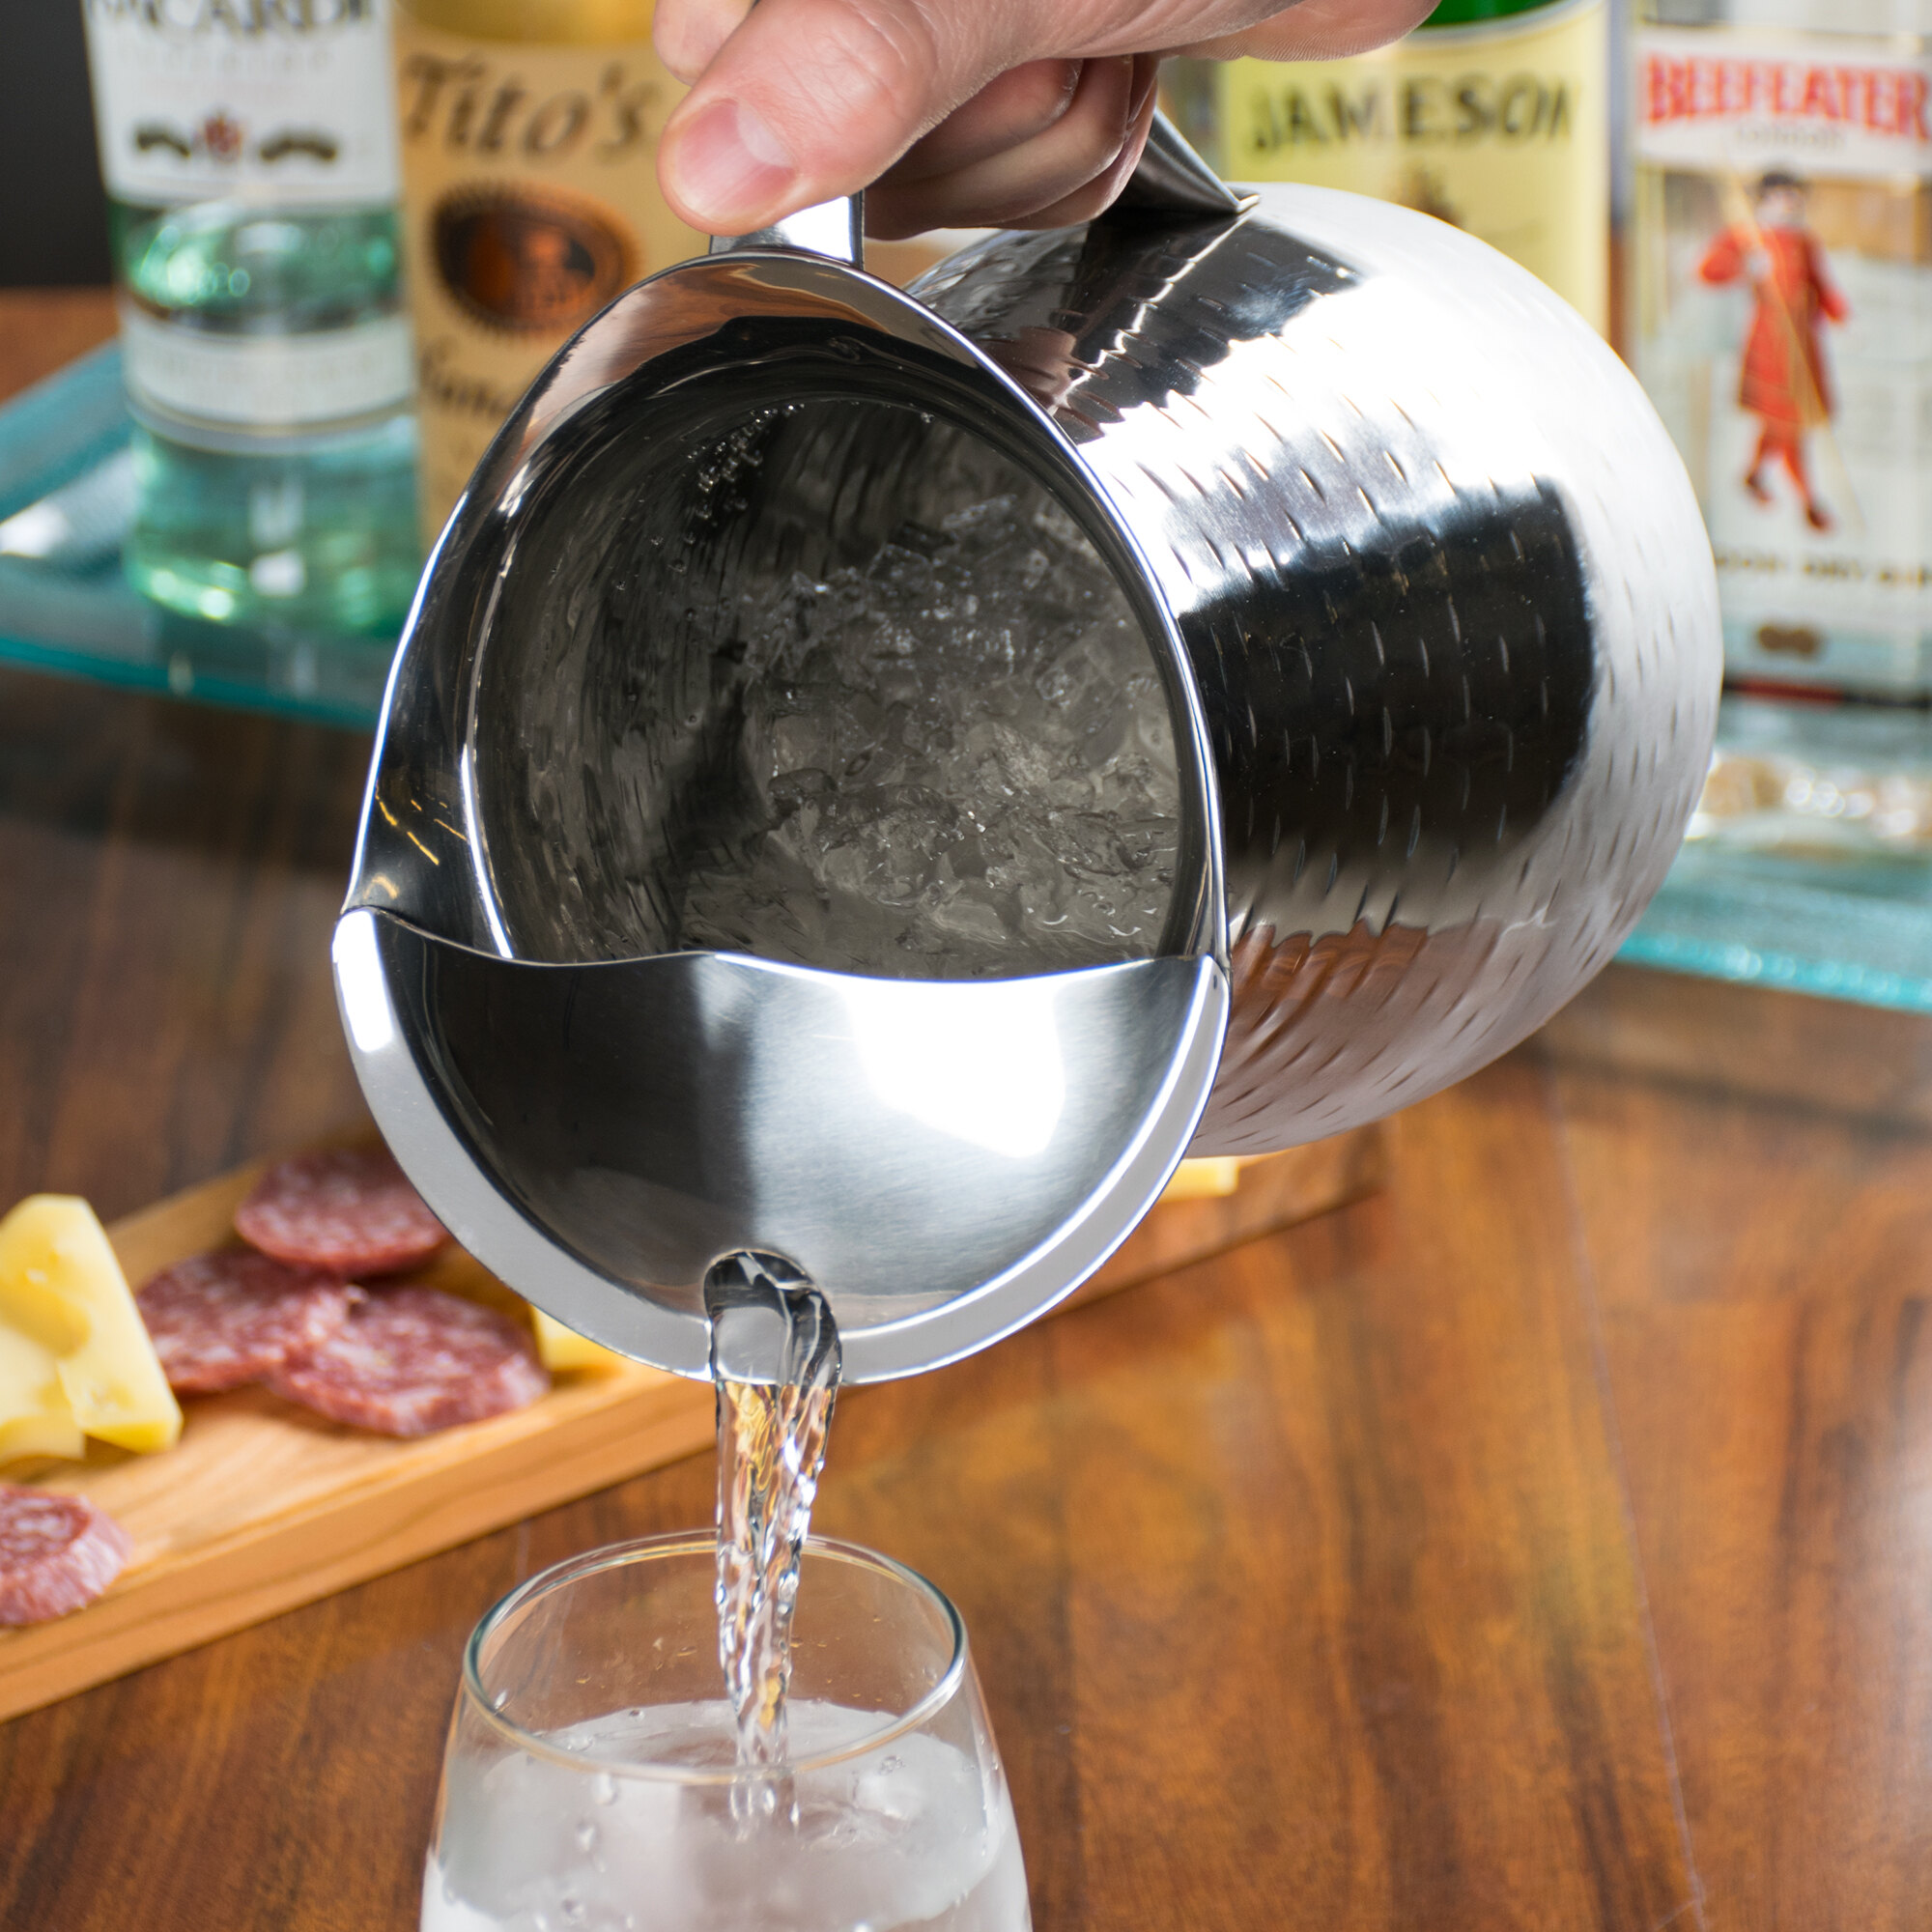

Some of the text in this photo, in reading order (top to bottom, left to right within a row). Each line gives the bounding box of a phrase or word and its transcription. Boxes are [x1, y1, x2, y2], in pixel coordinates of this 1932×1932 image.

[401, 53, 657, 159] Tito's
[1250, 71, 1578, 155] JAMESON
[1640, 55, 1930, 145] BEEFEATER
